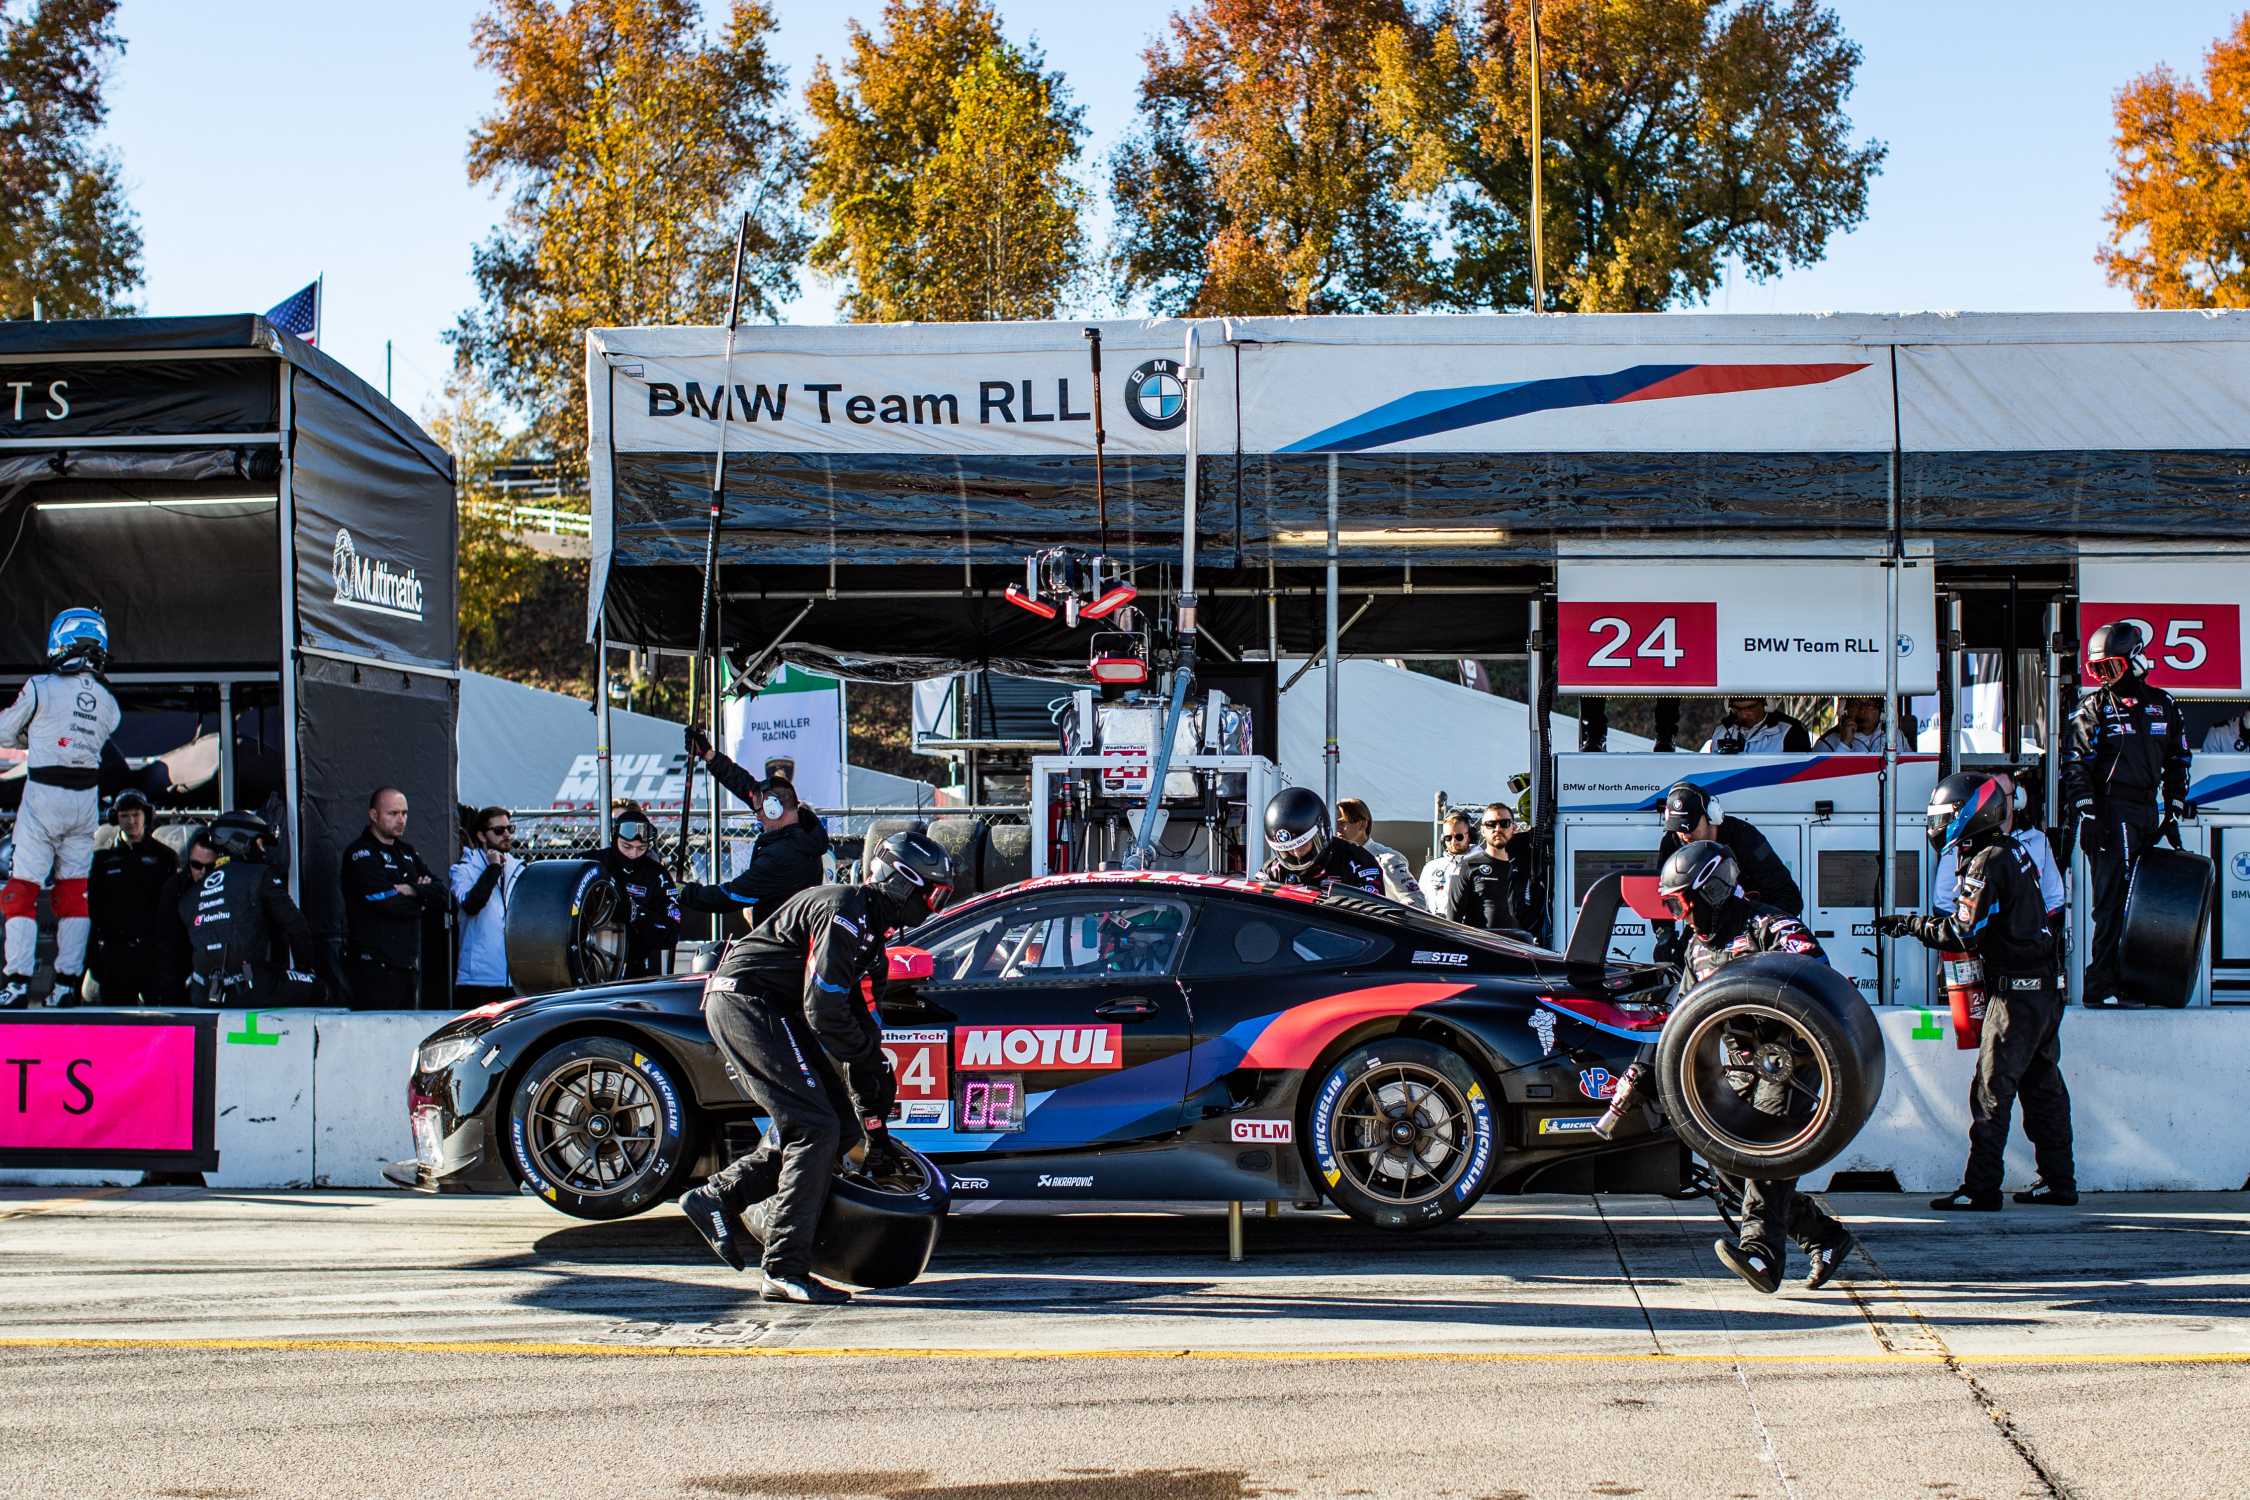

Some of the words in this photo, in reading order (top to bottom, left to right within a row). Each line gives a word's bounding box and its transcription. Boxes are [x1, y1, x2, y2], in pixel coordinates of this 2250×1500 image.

[648, 381, 788, 422] BMW
[804, 382, 959, 425] Team
[980, 377, 1091, 424] RLL
[355, 555, 422, 612] Multimatic
[1587, 616, 1685, 667] 24
[1744, 638, 1789, 651] BMW
[1794, 638, 1839, 652] Team
[1845, 638, 1879, 652] RLL
[751, 720, 771, 731] PAUL
[773, 717, 810, 729] MILLER
[762, 730, 796, 741] RACING
[555, 776, 712, 801] MLLER
[1588, 783, 1597, 791] of
[1598, 783, 1623, 791] North
[1624, 783, 1660, 791] America
[204, 911, 230, 923] idemitsu
[1431, 952, 1468, 963] STEP
[881, 1032, 944, 1041] therTech
[961, 1028, 1114, 1065] MOTUL
[1580, 1067, 1610, 1099] VP
[651, 1071, 678, 1131] MICHELIN
[1315, 1075, 1343, 1155] MICHELIN
[1234, 1123, 1289, 1138] GTLM
[513, 1122, 539, 1184] MICHELIN
[1460, 1115, 1490, 1196] MICHELIN
[952, 1181, 989, 1189] AERO
